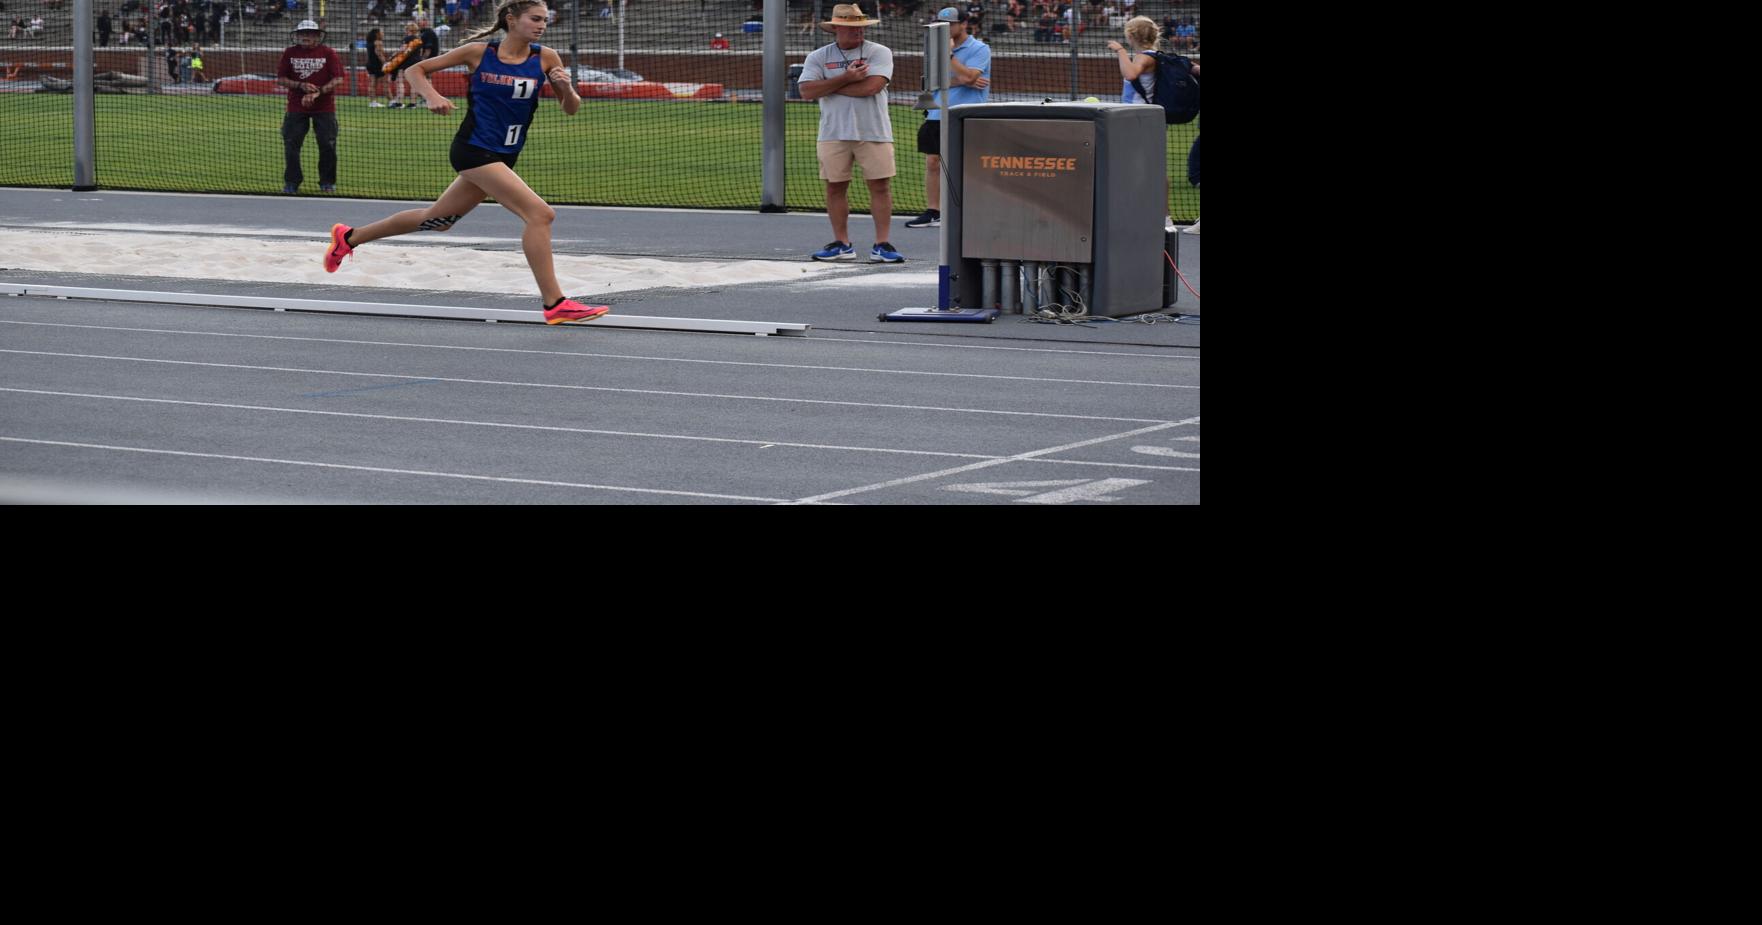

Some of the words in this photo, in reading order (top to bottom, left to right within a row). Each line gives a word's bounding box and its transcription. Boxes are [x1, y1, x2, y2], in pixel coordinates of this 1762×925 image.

[517, 80, 527, 98] 1
[509, 126, 518, 144] 1
[980, 155, 1077, 171] TENNESSEE
